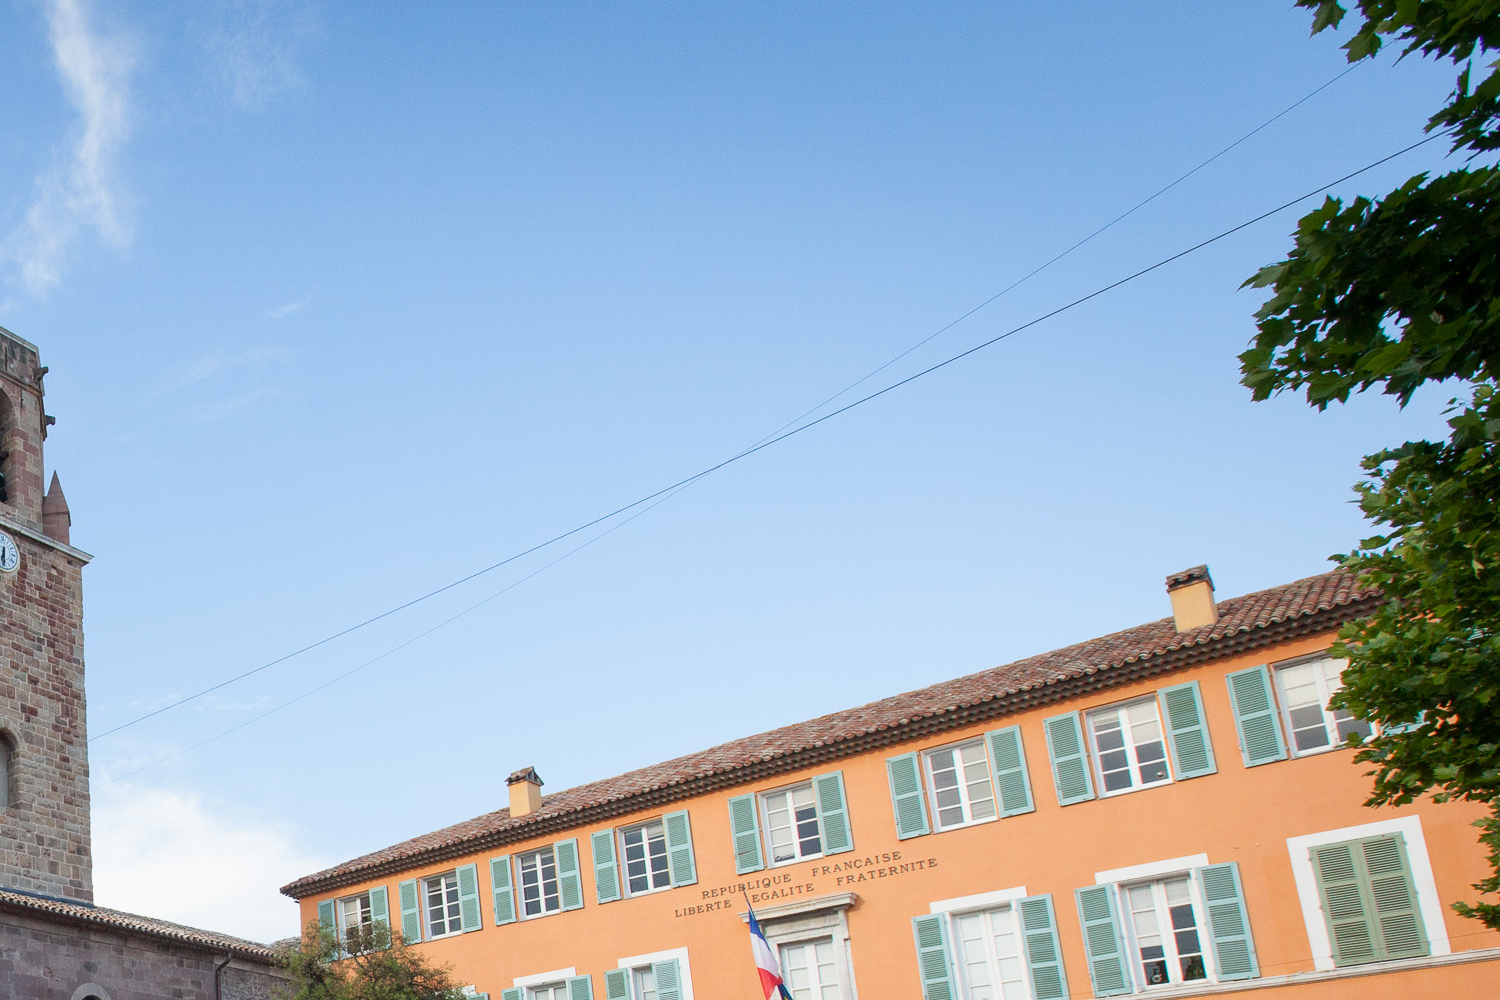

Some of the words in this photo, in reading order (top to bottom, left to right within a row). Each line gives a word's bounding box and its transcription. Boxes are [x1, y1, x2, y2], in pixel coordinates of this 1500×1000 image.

[675, 899, 732, 918] LIBERTE
[751, 882, 815, 904] EGALITE
[836, 858, 939, 886] FRATERNITE
[702, 873, 792, 900] REPUBLIQUE
[812, 850, 902, 877] FRANÇAISE
